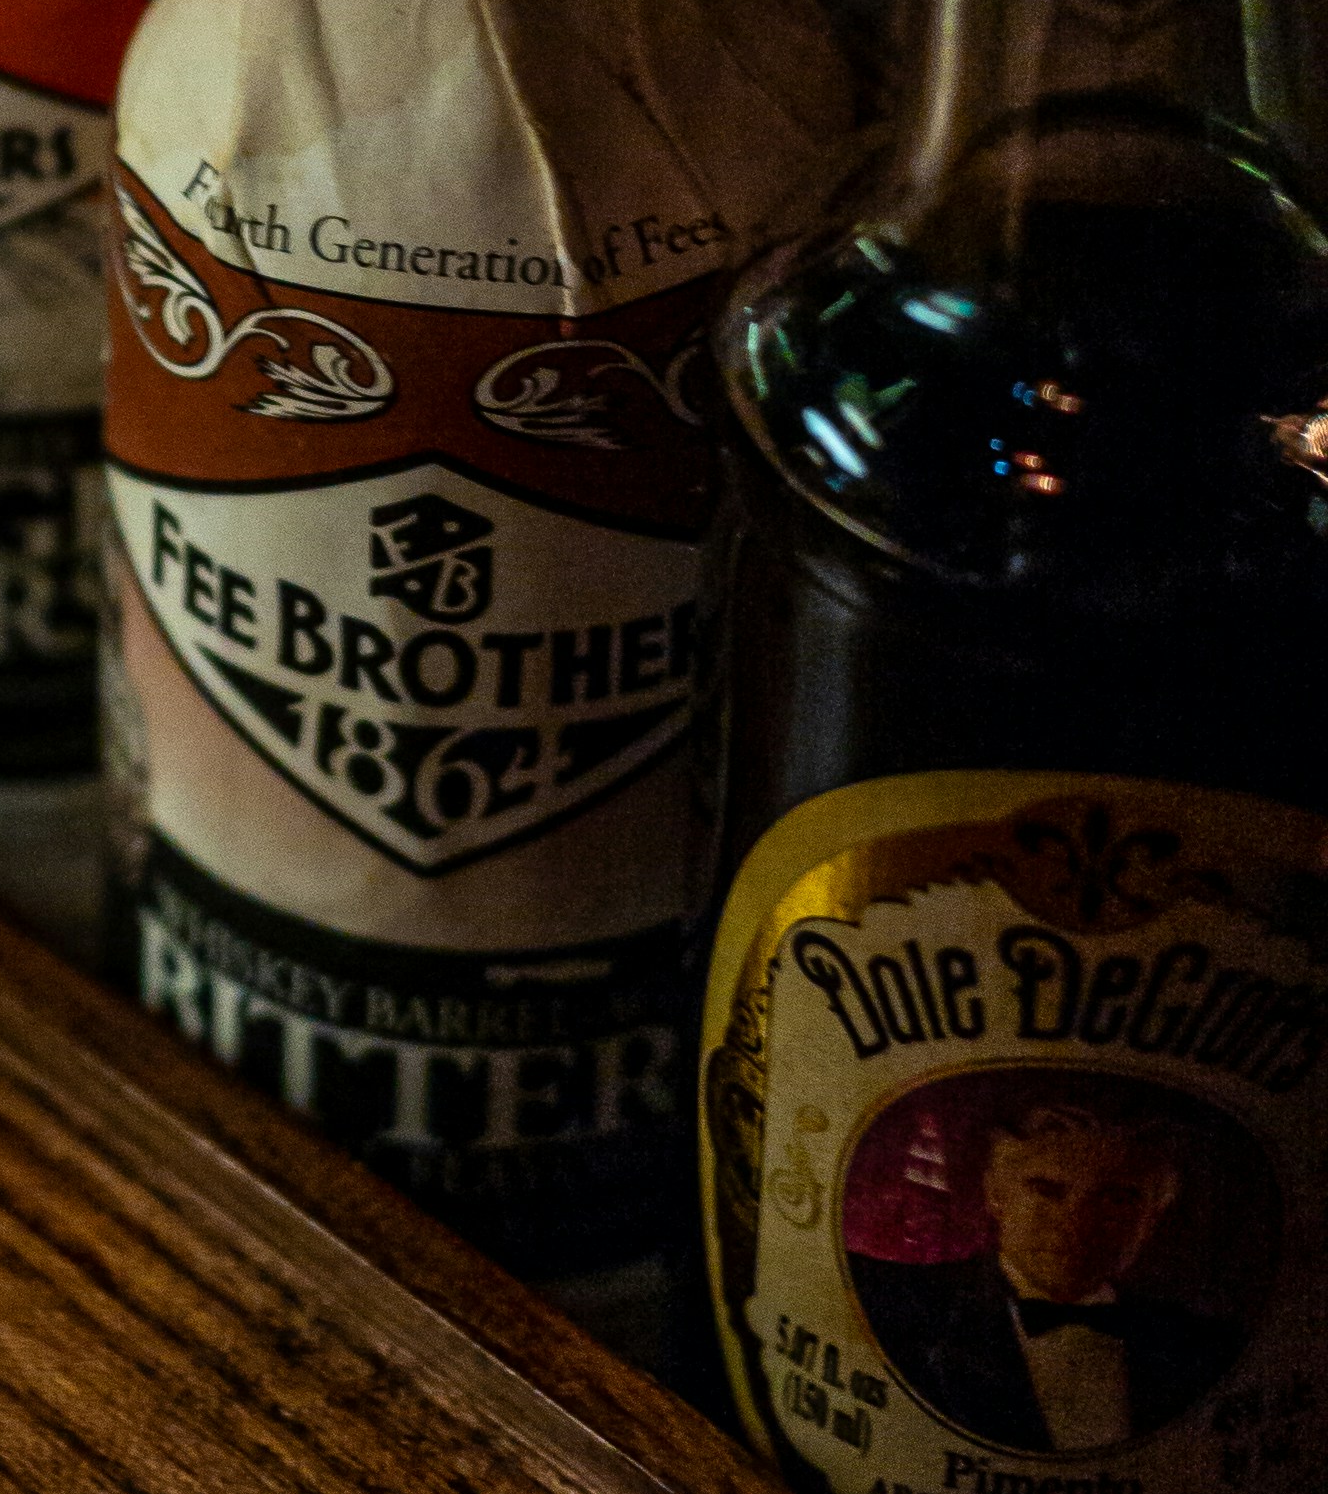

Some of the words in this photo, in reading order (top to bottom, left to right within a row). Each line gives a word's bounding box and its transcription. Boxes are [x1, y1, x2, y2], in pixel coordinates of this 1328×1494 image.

[585, 225, 621, 284] of
[151, 501, 256, 650] FEE
[278, 579, 714, 709] BROTHER
[137, 904, 681, 1153] BITTER
[793, 930, 984, 1059] Dale
